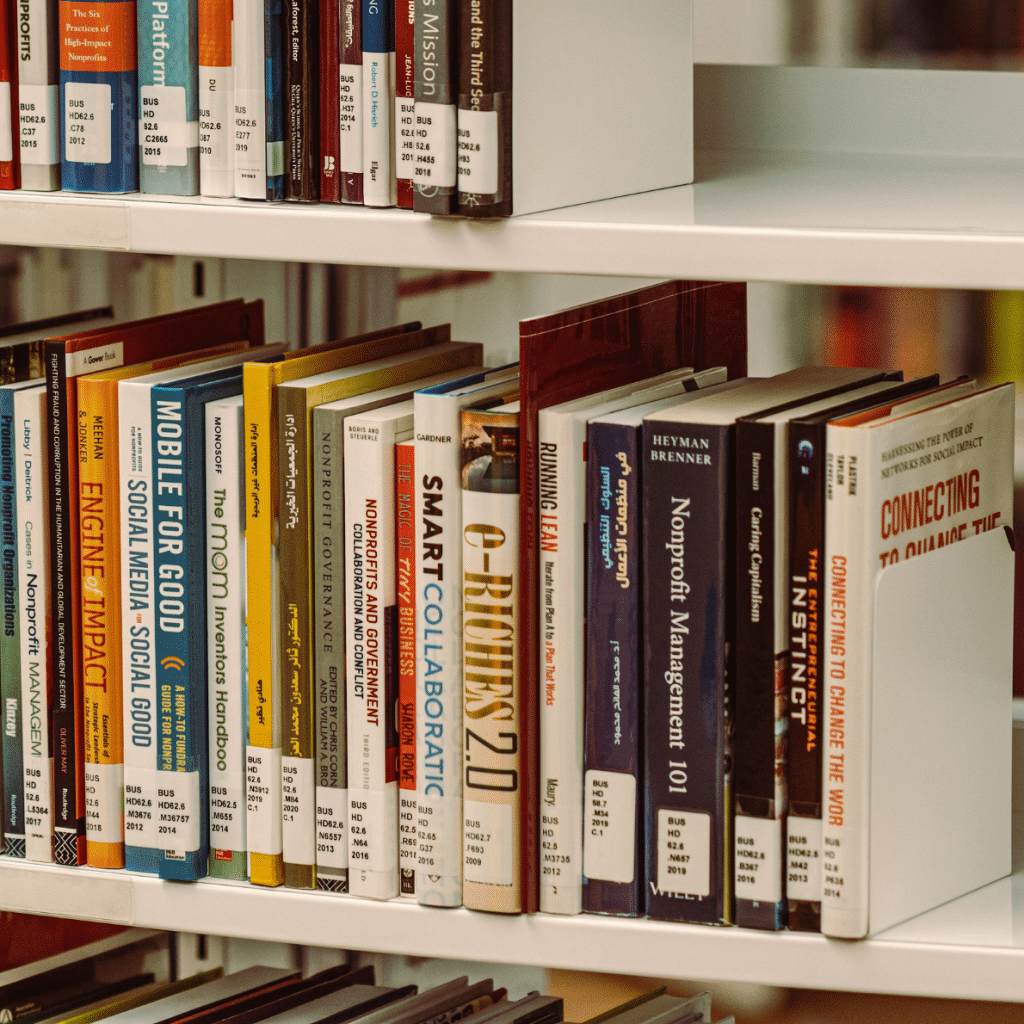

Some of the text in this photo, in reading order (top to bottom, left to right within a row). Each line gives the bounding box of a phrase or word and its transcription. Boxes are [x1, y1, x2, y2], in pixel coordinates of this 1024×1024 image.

[66, 23, 110, 33] Practices of
[72, 9, 100, 18] The Six
[471, 0, 482, 25] and
[471, 27, 483, 48] the
[64, 38, 112, 48] High-Impact
[68, 52, 107, 62] Nonprofits
[152, 1, 170, 86] Platform
[292, 37, 300, 61] Editor
[423, 13, 440, 96] Mission
[471, 51, 484, 86] Third
[69, 100, 84, 108] BUS
[69, 112, 94, 121] HD62.6
[70, 125, 84, 133] .C78
[69, 137, 85, 145] 2012
[79, 410, 88, 464] & JONKER
[93, 415, 104, 460] MEEHAN
[214, 416, 222, 475] MONOSOFF
[416, 434, 452, 444] GARDNER
[650, 450, 712, 466] BRENNER
[652, 434, 710, 450] HEYMAN
[285, 439, 298, 490] الجمعيات
[752, 452, 761, 491] Barman
[128, 478, 148, 547] SOCIAL
[156, 400, 185, 633] MOBILE FOR GOOD
[214, 488, 226, 518] The
[285, 492, 298, 529] الخيرية
[540, 442, 559, 552] RUNNING LEAN
[600, 466, 614, 569] السلوك التنظيمي
[615, 452, 632, 588] في منظمات الأعمال
[881, 468, 980, 541] CONNECTING
[322, 432, 332, 653] NONPROFIT GOVERNANCE
[422, 474, 444, 582] SMART
[26, 560, 34, 569] in
[81, 482, 107, 694] ENGINE of IMPACT
[129, 550, 150, 610] MEDIA
[748, 507, 764, 622] Caring Capitalism
[26, 574, 40, 656] Nonprofit
[353, 523, 364, 699] COLLABORATION AND CONFLICT
[366, 498, 378, 726] NONPROFITS AND GOVERNMENT
[130, 625, 151, 693] SOCIAL
[214, 606, 228, 685] Inventors
[464, 523, 518, 792] e-RICHES 2.0
[664, 496, 691, 794] Nonprofit Management 101
[792, 576, 807, 725] INSTINCT
[806, 548, 818, 752] THE ENTREPRENEURIAL
[5, 698, 17, 737] Kinzey
[30, 662, 42, 757] MANAGEM
[828, 556, 847, 826] CONNECTING TO CHANGE THE WOR
[130, 698, 152, 748] GOOD
[216, 690, 228, 772] Handboo
[158, 790, 174, 798] BUS
[158, 802, 186, 810] HD62.6
[158, 826, 176, 834] 2014
